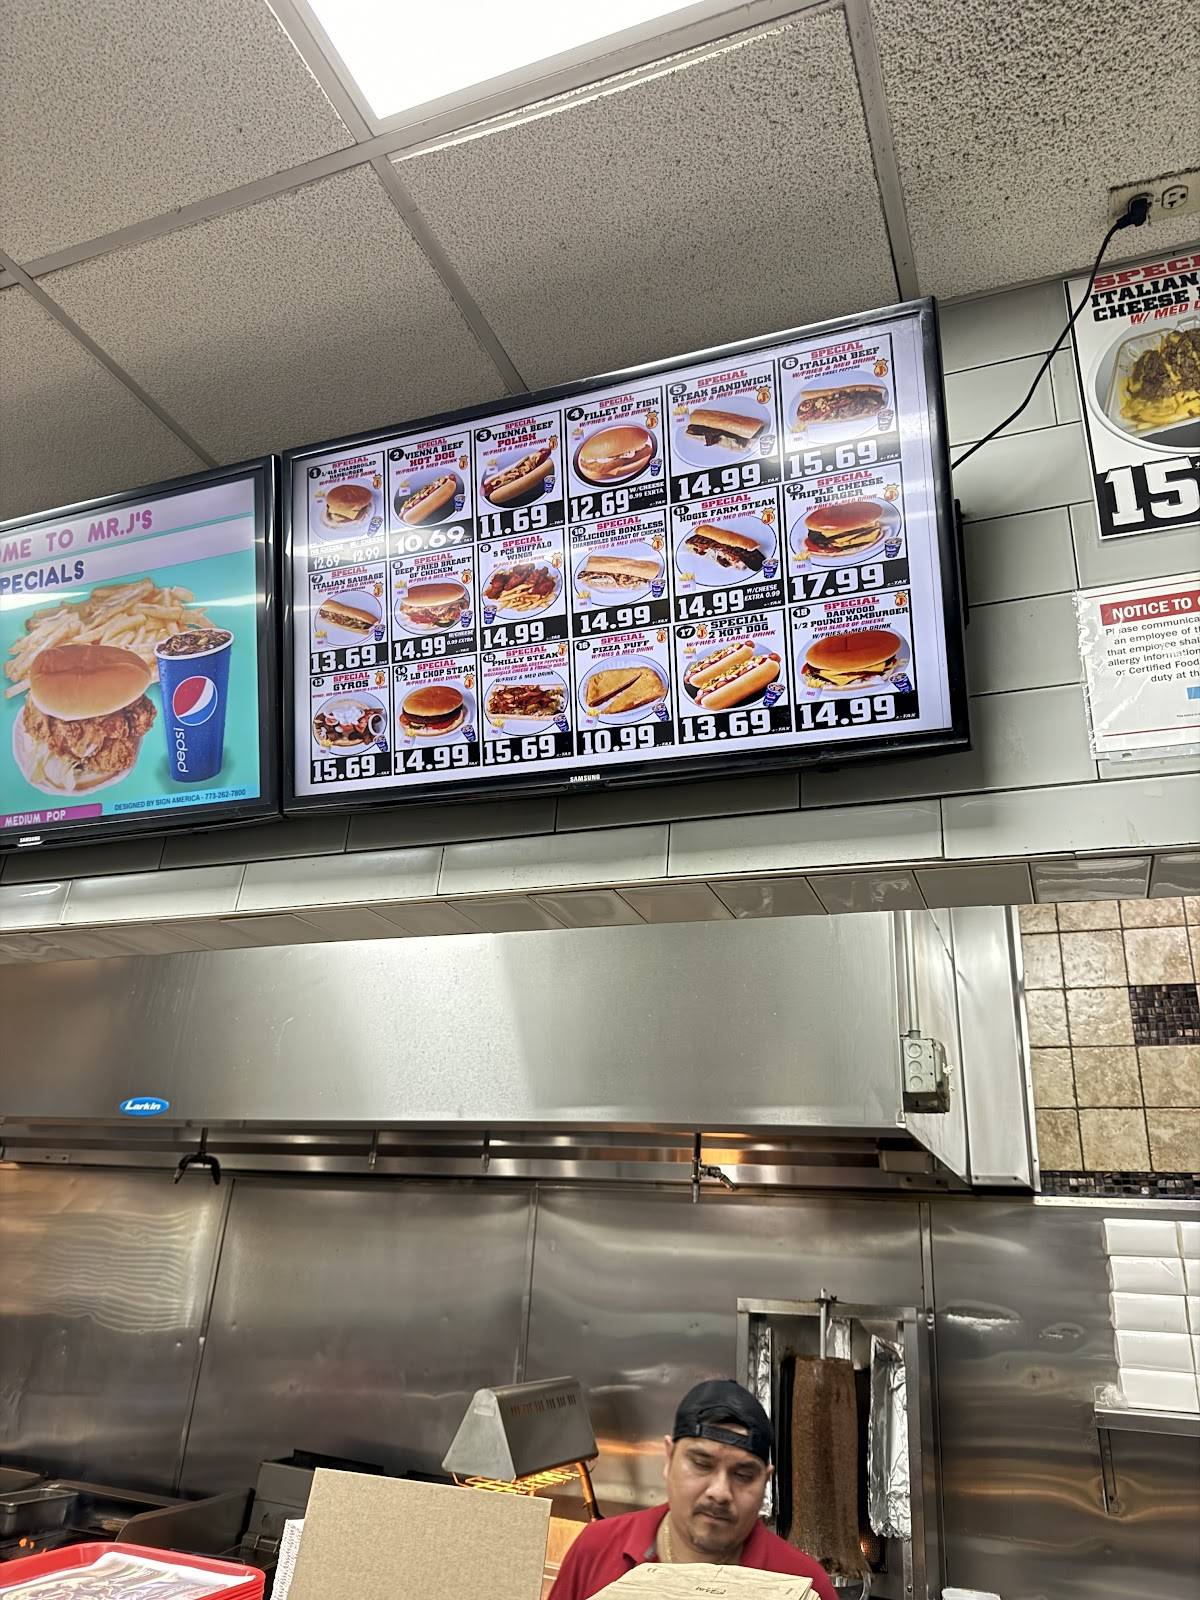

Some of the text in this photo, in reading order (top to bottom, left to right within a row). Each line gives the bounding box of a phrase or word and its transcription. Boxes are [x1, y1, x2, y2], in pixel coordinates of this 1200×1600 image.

[1091, 272, 1198, 307] ITALIAN
[1093, 290, 1190, 322] CHEESE
[1130, 312, 1150, 325] W/
[811, 342, 863, 358] SPECIAL
[800, 347, 880, 370] ITALIAN BEEF
[698, 370, 748, 386] SPECIAL
[672, 375, 771, 403] STEAK SANDWICH
[584, 398, 659, 420] FILLET OF FISH
[600, 395, 634, 408] SPECIAL
[492, 421, 553, 440] VIENNA BEEF
[505, 418, 536, 430] SPECIAL
[417, 438, 447, 450] SPECIAL
[497, 433, 536, 447] POLISH
[405, 441, 464, 460] VIENNA BEEF
[332, 457, 368, 469] SPECIAL
[409, 451, 455, 467] HOT DOG
[789, 440, 878, 478] 15.69
[679, 464, 761, 500] 14.99
[817, 471, 872, 488] SPECIAL
[790, 477, 884, 500] TRIPLE CHEESE
[815, 489, 864, 504] BURGER
[1105, 457, 1200, 526] 15
[571, 489, 629, 522] 12.69
[701, 495, 751, 509] SPECIAL
[710, 505, 738, 517] FARM
[742, 498, 775, 510] STEAK
[480, 504, 547, 538] 11.69
[597, 517, 641, 530] SPECIAL
[46, 529, 73, 552] TO
[88, 510, 153, 543] MR.J'S
[572, 530, 616, 543] DELICIOUS
[619, 521, 663, 534] BONELESS
[395, 526, 464, 554] 10.69
[502, 536, 542, 548] SPECIAL
[517, 541, 552, 553] BUFFALO
[415, 553, 452, 564] SPECIAL
[507, 552, 532, 560] WINGS
[332, 567, 367, 578] SPECIAL
[395, 556, 471, 575] DEEP FRIED BREAST
[421, 566, 452, 577] CHICKEN
[313, 579, 345, 590] ITALIAN
[348, 572, 383, 584] SAUSAGE
[792, 563, 884, 600] 17.99
[678, 590, 744, 619] 14.99
[824, 597, 880, 611] SPECIAL
[826, 605, 875, 618] DAGWOOD
[1112, 597, 1192, 620] NOTICE TO
[580, 606, 650, 633] 14.99
[710, 614, 768, 629] SPECIAL
[811, 616, 843, 628] POUND
[846, 607, 908, 622] HAMBURGER
[861, 618, 885, 626] CHEESE
[483, 621, 544, 649] 14.99
[719, 627, 743, 637] HOT
[746, 624, 768, 634] DOG
[869, 623, 892, 631] DRINK
[1106, 626, 1138, 635] Plase
[601, 633, 645, 644] SPECIAL
[686, 639, 716, 647] W/FRIES
[726, 633, 750, 642] LARGE
[752, 630, 776, 638] DRINK
[1130, 630, 1177, 641] employee
[394, 636, 446, 660] 14.99
[506, 646, 546, 657] SPECIAL
[592, 645, 621, 654] PIZZA
[624, 640, 649, 649] PUFF
[1107, 648, 1126, 656] that
[1130, 641, 1176, 652] employee
[312, 645, 376, 673] 13.69
[417, 660, 456, 671] SPECIAL
[492, 652, 558, 666] PHILLY STEAK
[1108, 657, 1140, 666] allergy
[1129, 663, 1171, 674] Certified
[1175, 659, 1200, 668] Food
[333, 672, 370, 683] SPECIAL
[423, 669, 445, 679] CHOP
[447, 665, 474, 675] STEAK
[1151, 674, 1172, 682] duty
[333, 680, 369, 691] GYROS
[800, 695, 895, 729] 14.99
[682, 709, 771, 742] 13.69
[583, 725, 655, 754] 10.99
[173, 727, 188, 773] pepsi
[484, 735, 556, 764] 15.69
[394, 744, 469, 774] 14.99
[313, 755, 375, 782] 15.69
[570, 774, 600, 782] SAMSUNG
[114, 802, 145, 810] DESIGNED
[172, 794, 200, 803] AMERICA
[4, 810, 66, 827] MEDIUM POP
[125, 1100, 160, 1110] Larkin
